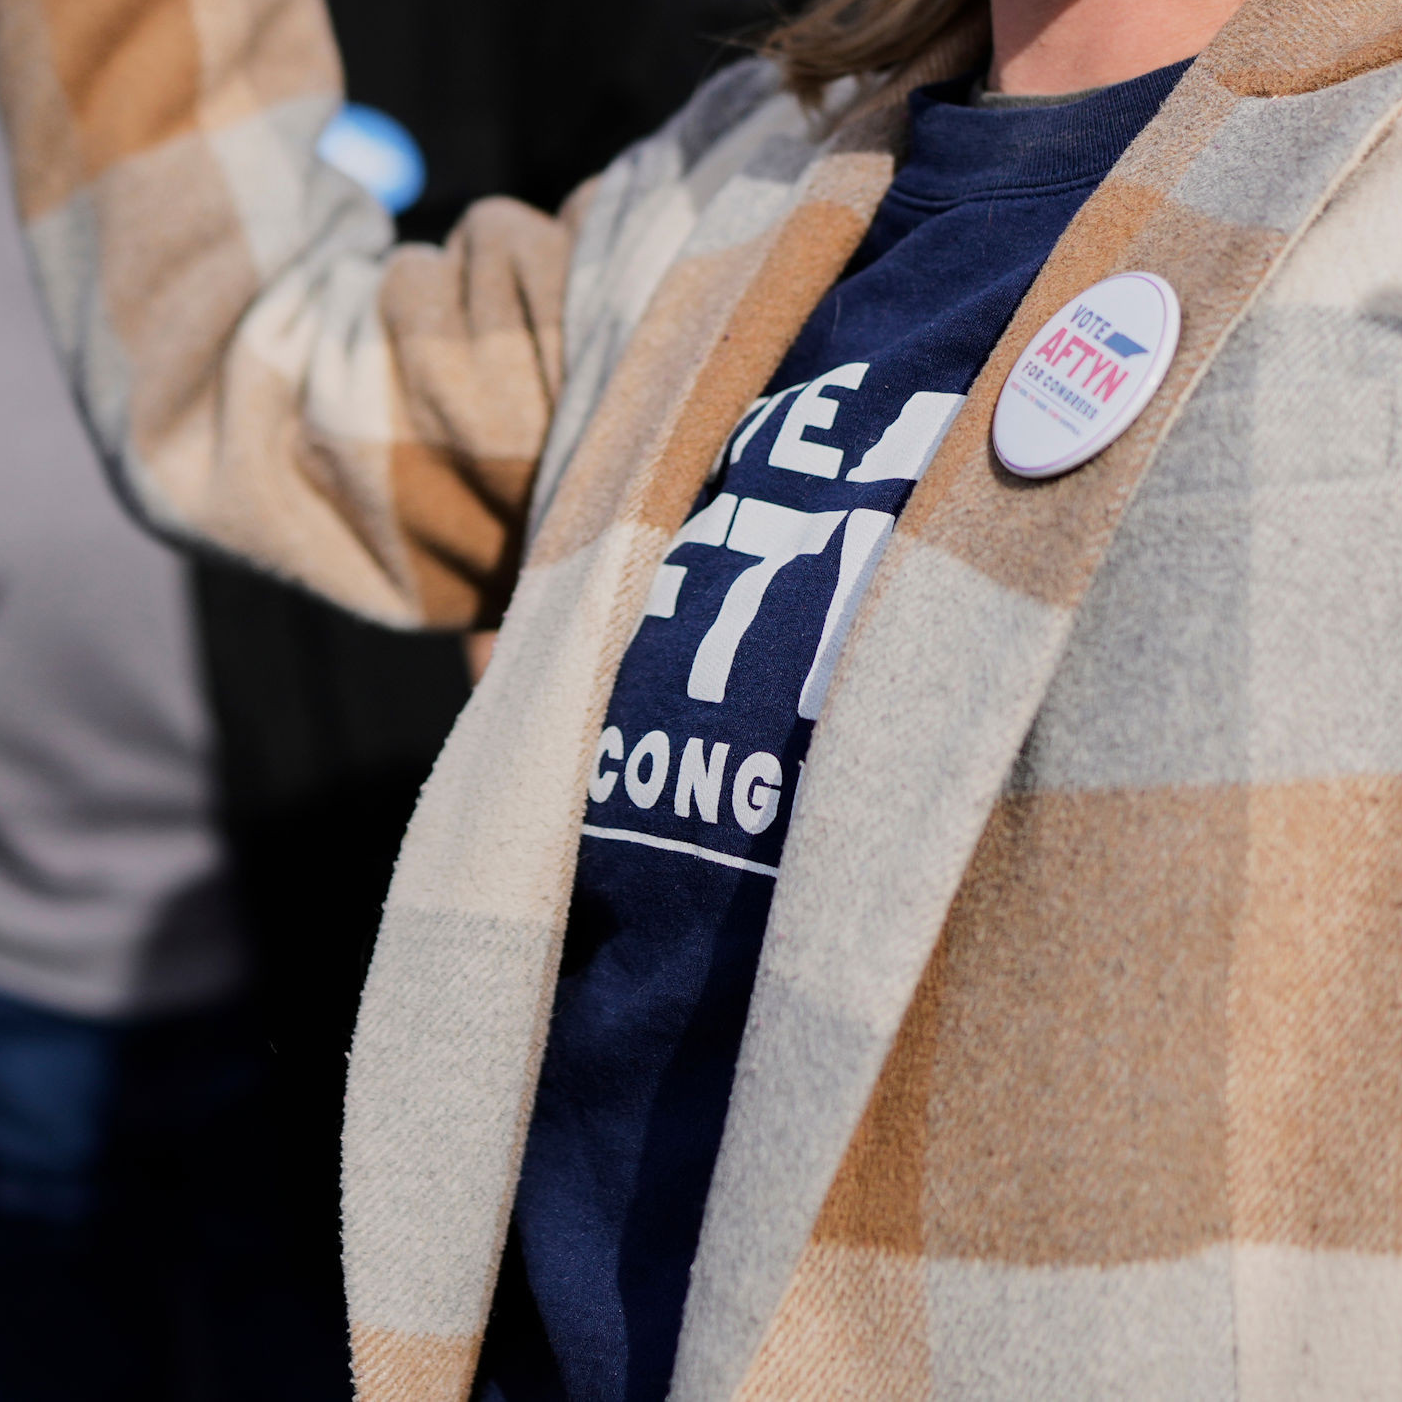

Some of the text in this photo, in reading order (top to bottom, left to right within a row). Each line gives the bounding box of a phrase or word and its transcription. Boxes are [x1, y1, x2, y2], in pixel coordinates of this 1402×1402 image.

[1070, 303, 1112, 340] VOTE
[1021, 360, 1045, 381] FOR
[1035, 327, 1130, 403] AFTYN
[588, 725, 806, 835] CONG
